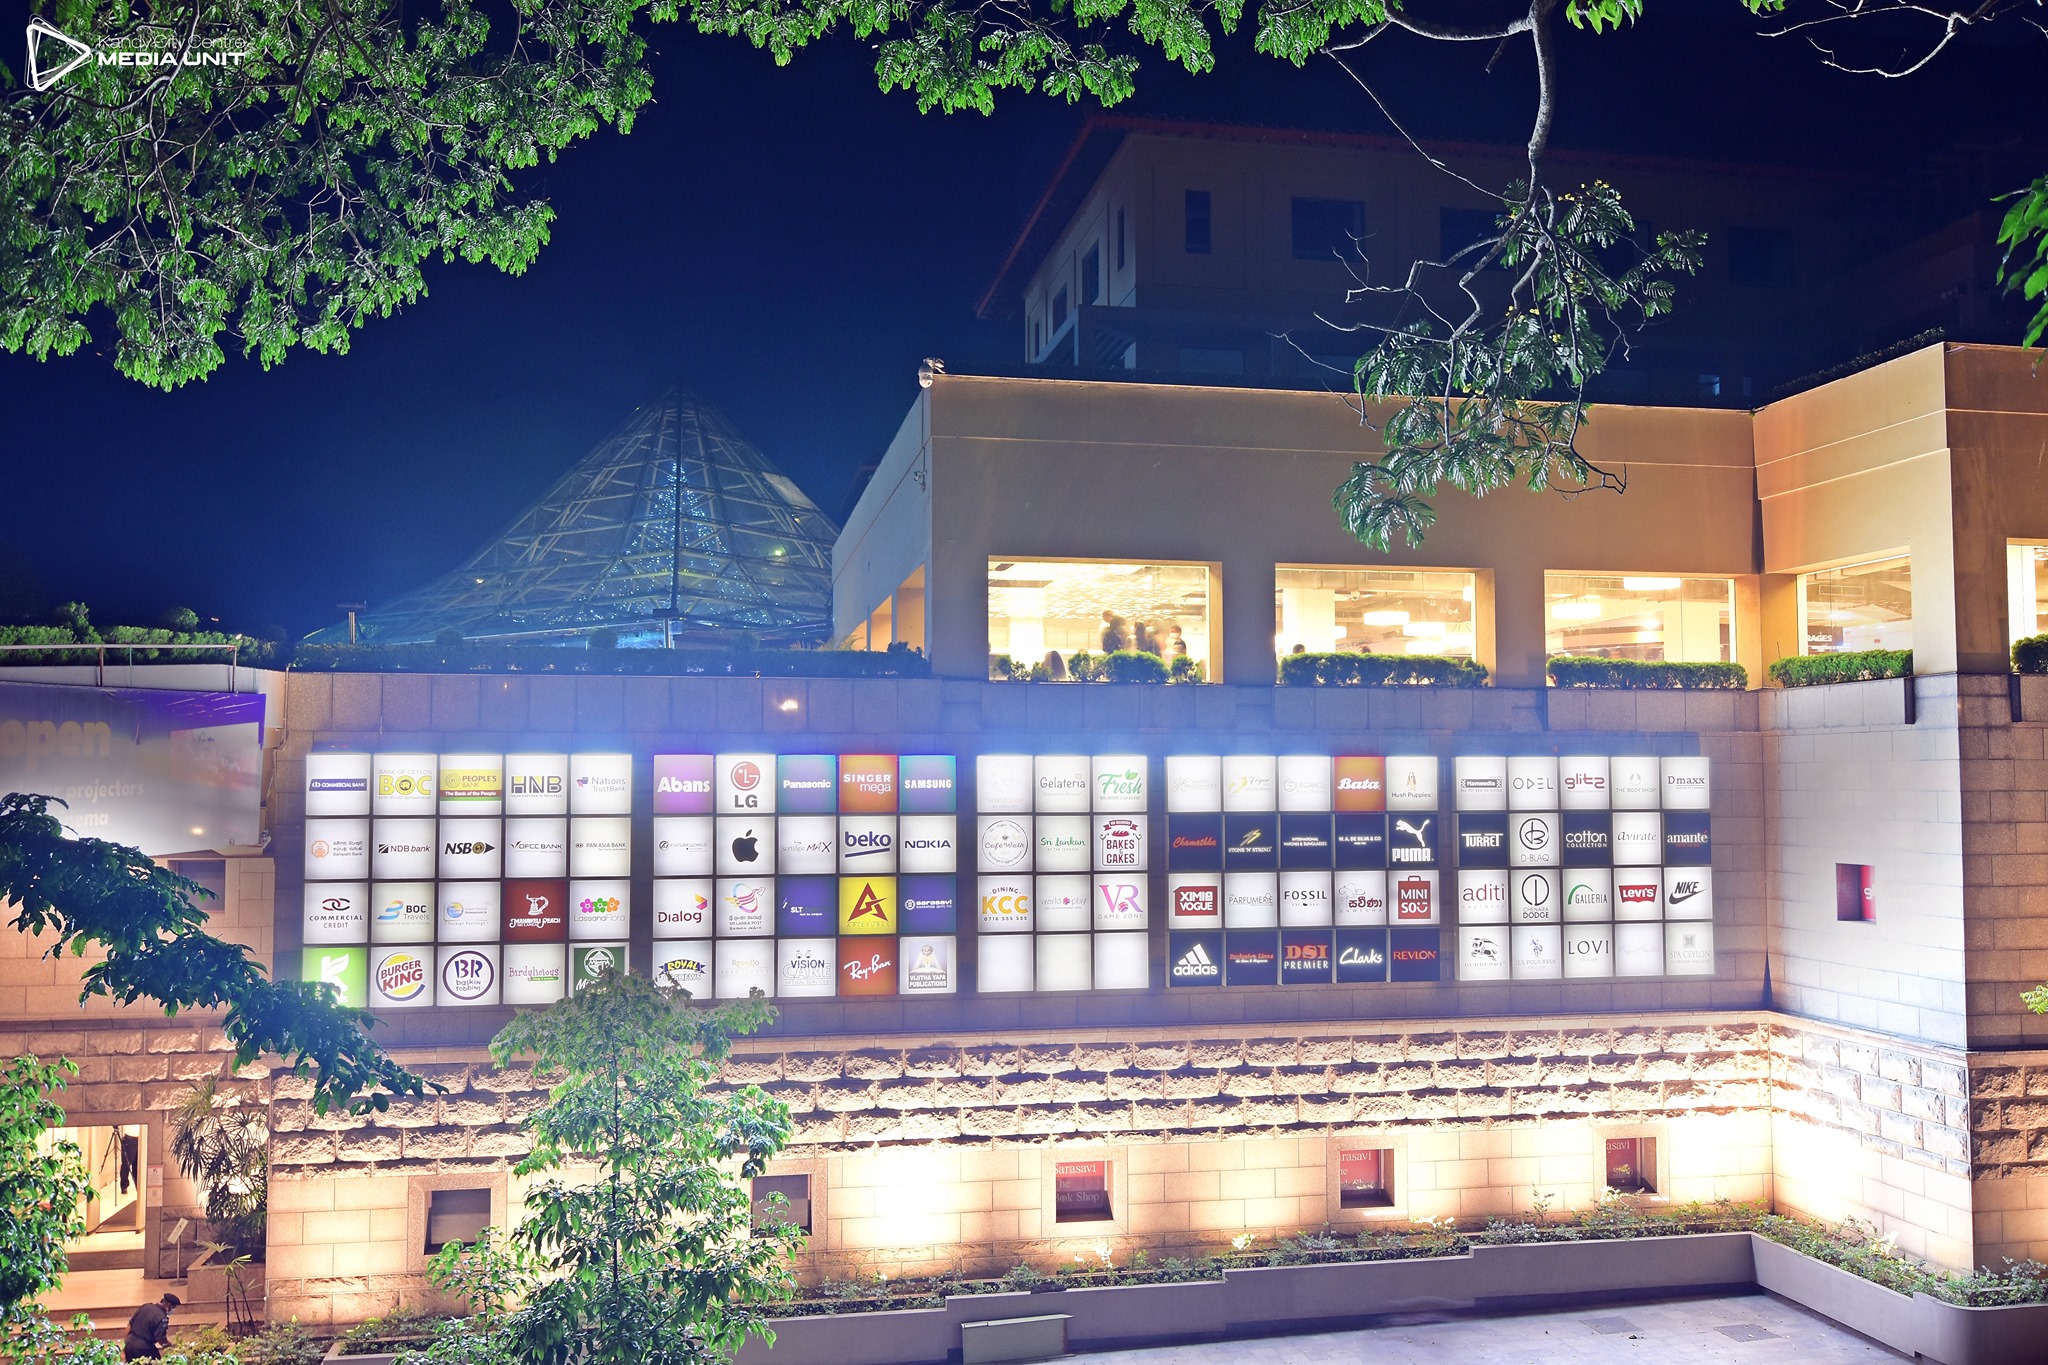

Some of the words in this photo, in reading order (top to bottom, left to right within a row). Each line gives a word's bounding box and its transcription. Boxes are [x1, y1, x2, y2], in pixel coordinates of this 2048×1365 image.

[591, 776, 626, 785] Nations
[783, 779, 831, 789] Panasonic
[843, 774, 891, 782] SINGER
[904, 779, 951, 789] SAMSUNG
[1040, 777, 1086, 788] Gelateria
[1097, 773, 1143, 795] Fresh
[1337, 778, 1380, 789] Bata
[1512, 778, 1554, 789] ODEL
[379, 775, 433, 795] BOC
[511, 775, 562, 794] HNB
[657, 777, 710, 793] Abans
[860, 783, 891, 794] mega
[66, 779, 144, 805] projectors
[734, 794, 758, 808] LG
[845, 831, 892, 846] beko
[1040, 837, 1053, 846] Sri
[1054, 837, 1086, 846] Lankan
[1172, 836, 1217, 848] Chamathka
[1461, 833, 1504, 847] TURRET
[1565, 830, 1607, 843] cotton
[1666, 830, 1708, 843] amanté
[411, 844, 431, 852] bank
[445, 842, 472, 855] NSB
[806, 841, 832, 853] MAX
[904, 840, 951, 848] NOKIA
[1106, 839, 1135, 849] BAKES
[1106, 854, 1135, 864] CAKES
[1392, 848, 1431, 862] PUMA
[1521, 854, 1550, 862] D-BLAQ
[1462, 884, 1505, 901] aditi
[1674, 881, 1699, 893] NIKE
[1098, 884, 1144, 913] VR
[1284, 890, 1328, 900] FOSSIL
[1401, 889, 1428, 899] MINI
[1575, 894, 1608, 904] GALLERIA
[982, 896, 1029, 914] KCC
[1041, 897, 1061, 905] world
[1071, 897, 1087, 906] play
[1180, 902, 1213, 911] VOGUE
[406, 905, 427, 913] BOC
[403, 913, 430, 921] Travels
[658, 911, 702, 923] Dialog
[1284, 944, 1328, 959] DSI
[1568, 940, 1609, 955] LOVI
[1339, 947, 1383, 964] Clarks
[1393, 950, 1437, 960] REVLON
[1669, 950, 1681, 958] SPA
[1683, 950, 1710, 958] CEYLON
[380, 960, 422, 979] BURGER
[455, 959, 483, 978] BR
[667, 959, 699, 971] ROYAL
[790, 959, 825, 969] VISION
[1173, 963, 1218, 976] adidas
[1284, 961, 1329, 969] PREMIER
[509, 966, 560, 981] Birdylicious
[783, 963, 832, 979] CARE
[381, 968, 423, 992] KING
[1076, 1191, 1100, 1203] Shop
